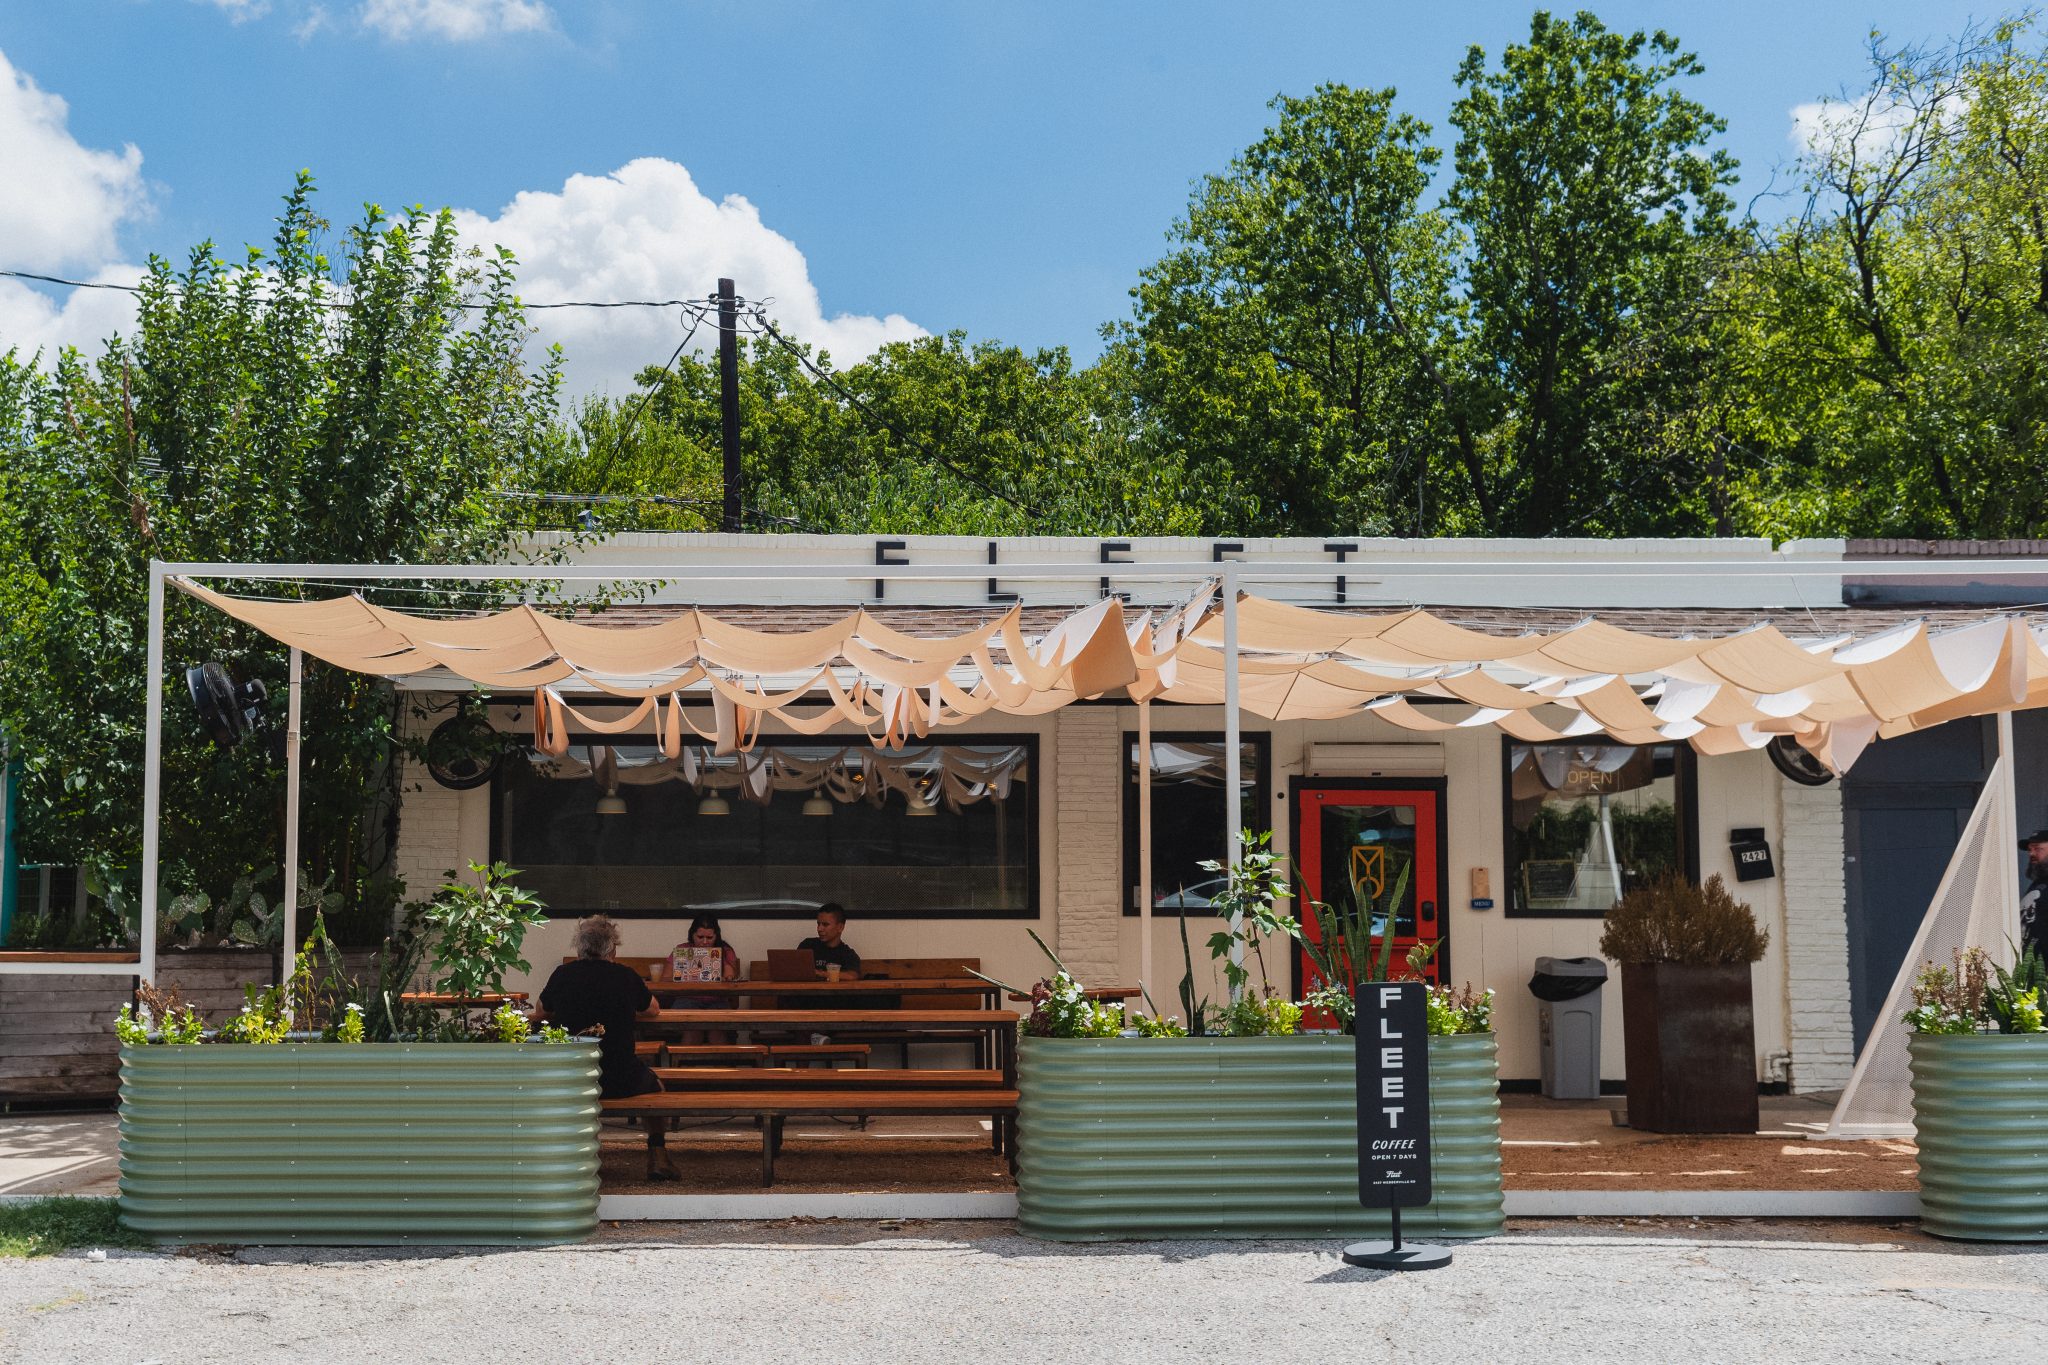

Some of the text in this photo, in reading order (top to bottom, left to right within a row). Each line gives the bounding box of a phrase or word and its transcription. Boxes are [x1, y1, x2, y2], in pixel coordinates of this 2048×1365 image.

[1567, 770, 1613, 785] OPEN
[1742, 850, 1765, 862] 2427
[1380, 988, 1404, 1128] FLEET
[1372, 1139, 1416, 1150] COFFEE
